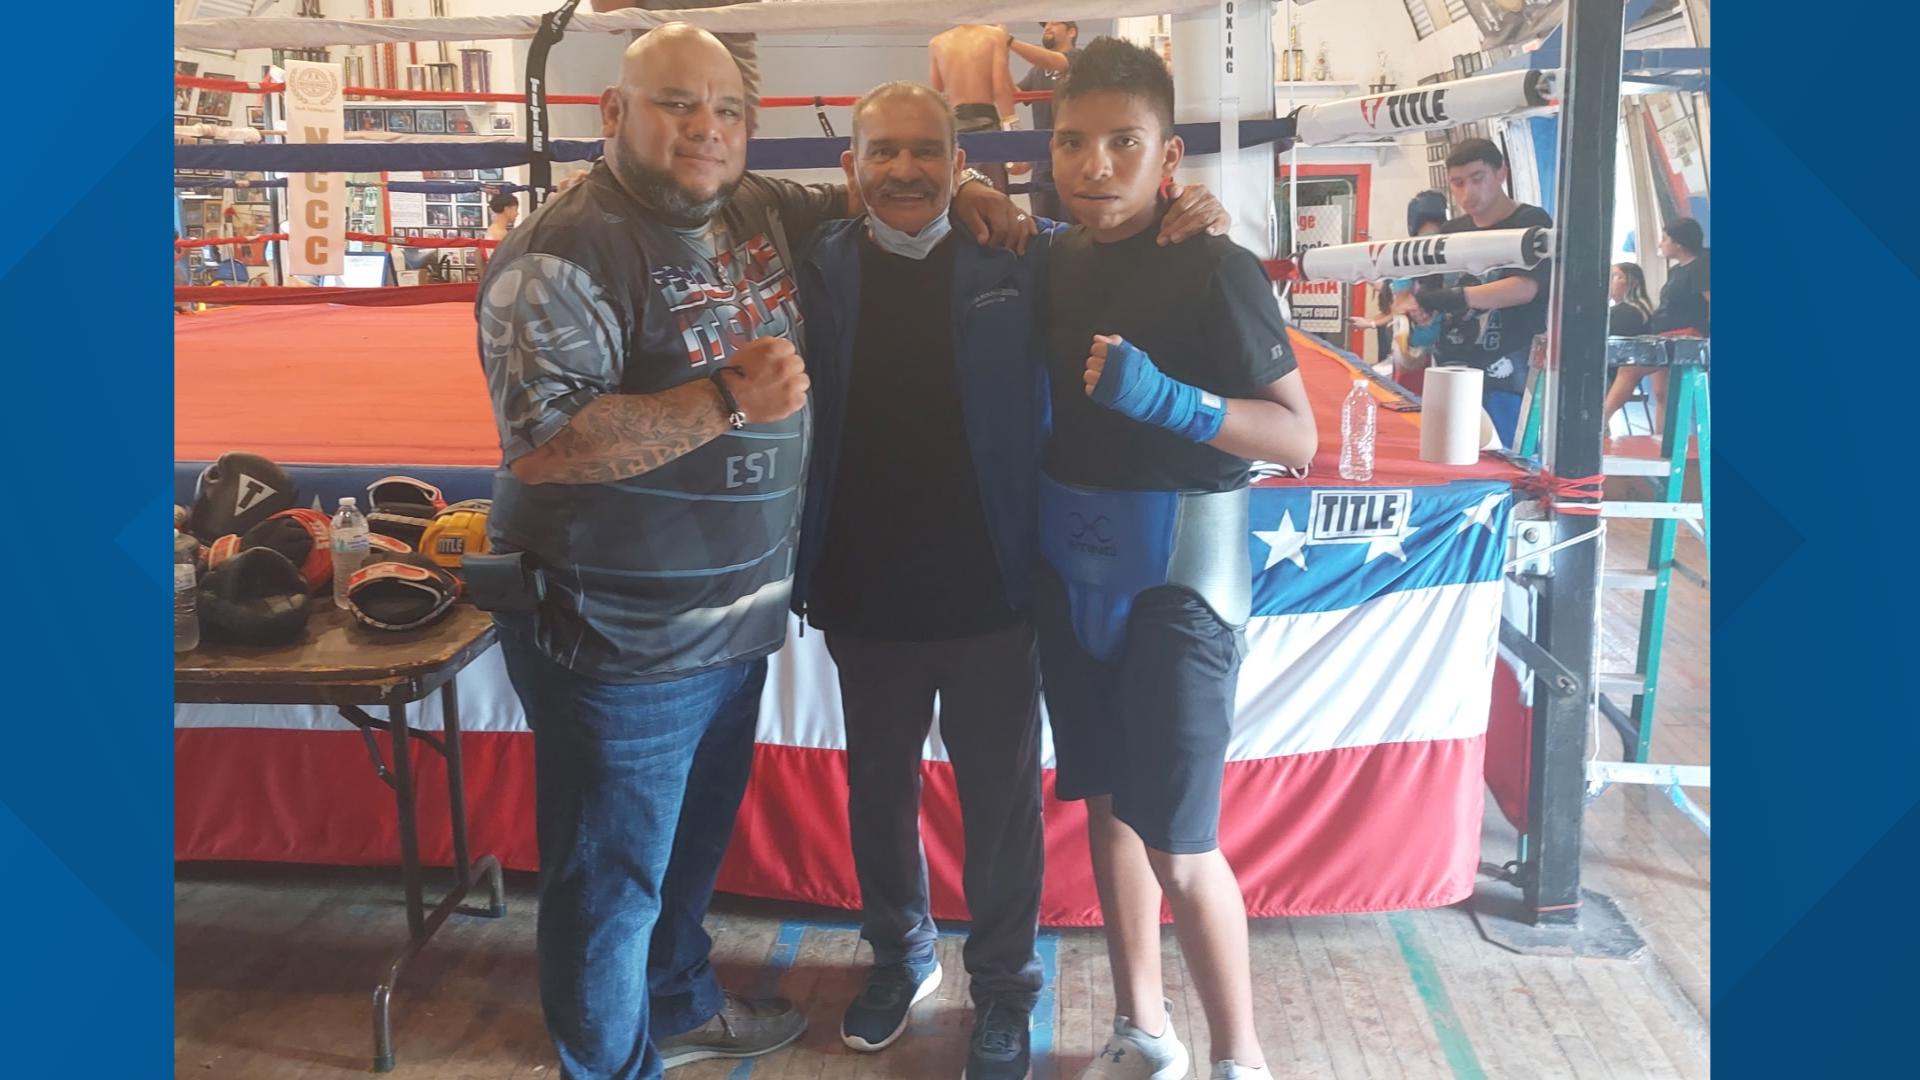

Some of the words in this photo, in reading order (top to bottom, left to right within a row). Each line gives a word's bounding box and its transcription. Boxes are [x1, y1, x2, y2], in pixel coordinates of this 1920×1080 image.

[1386, 88, 1449, 129] TITLE
[726, 447, 779, 489] EST
[1322, 495, 1397, 532] TITLE
